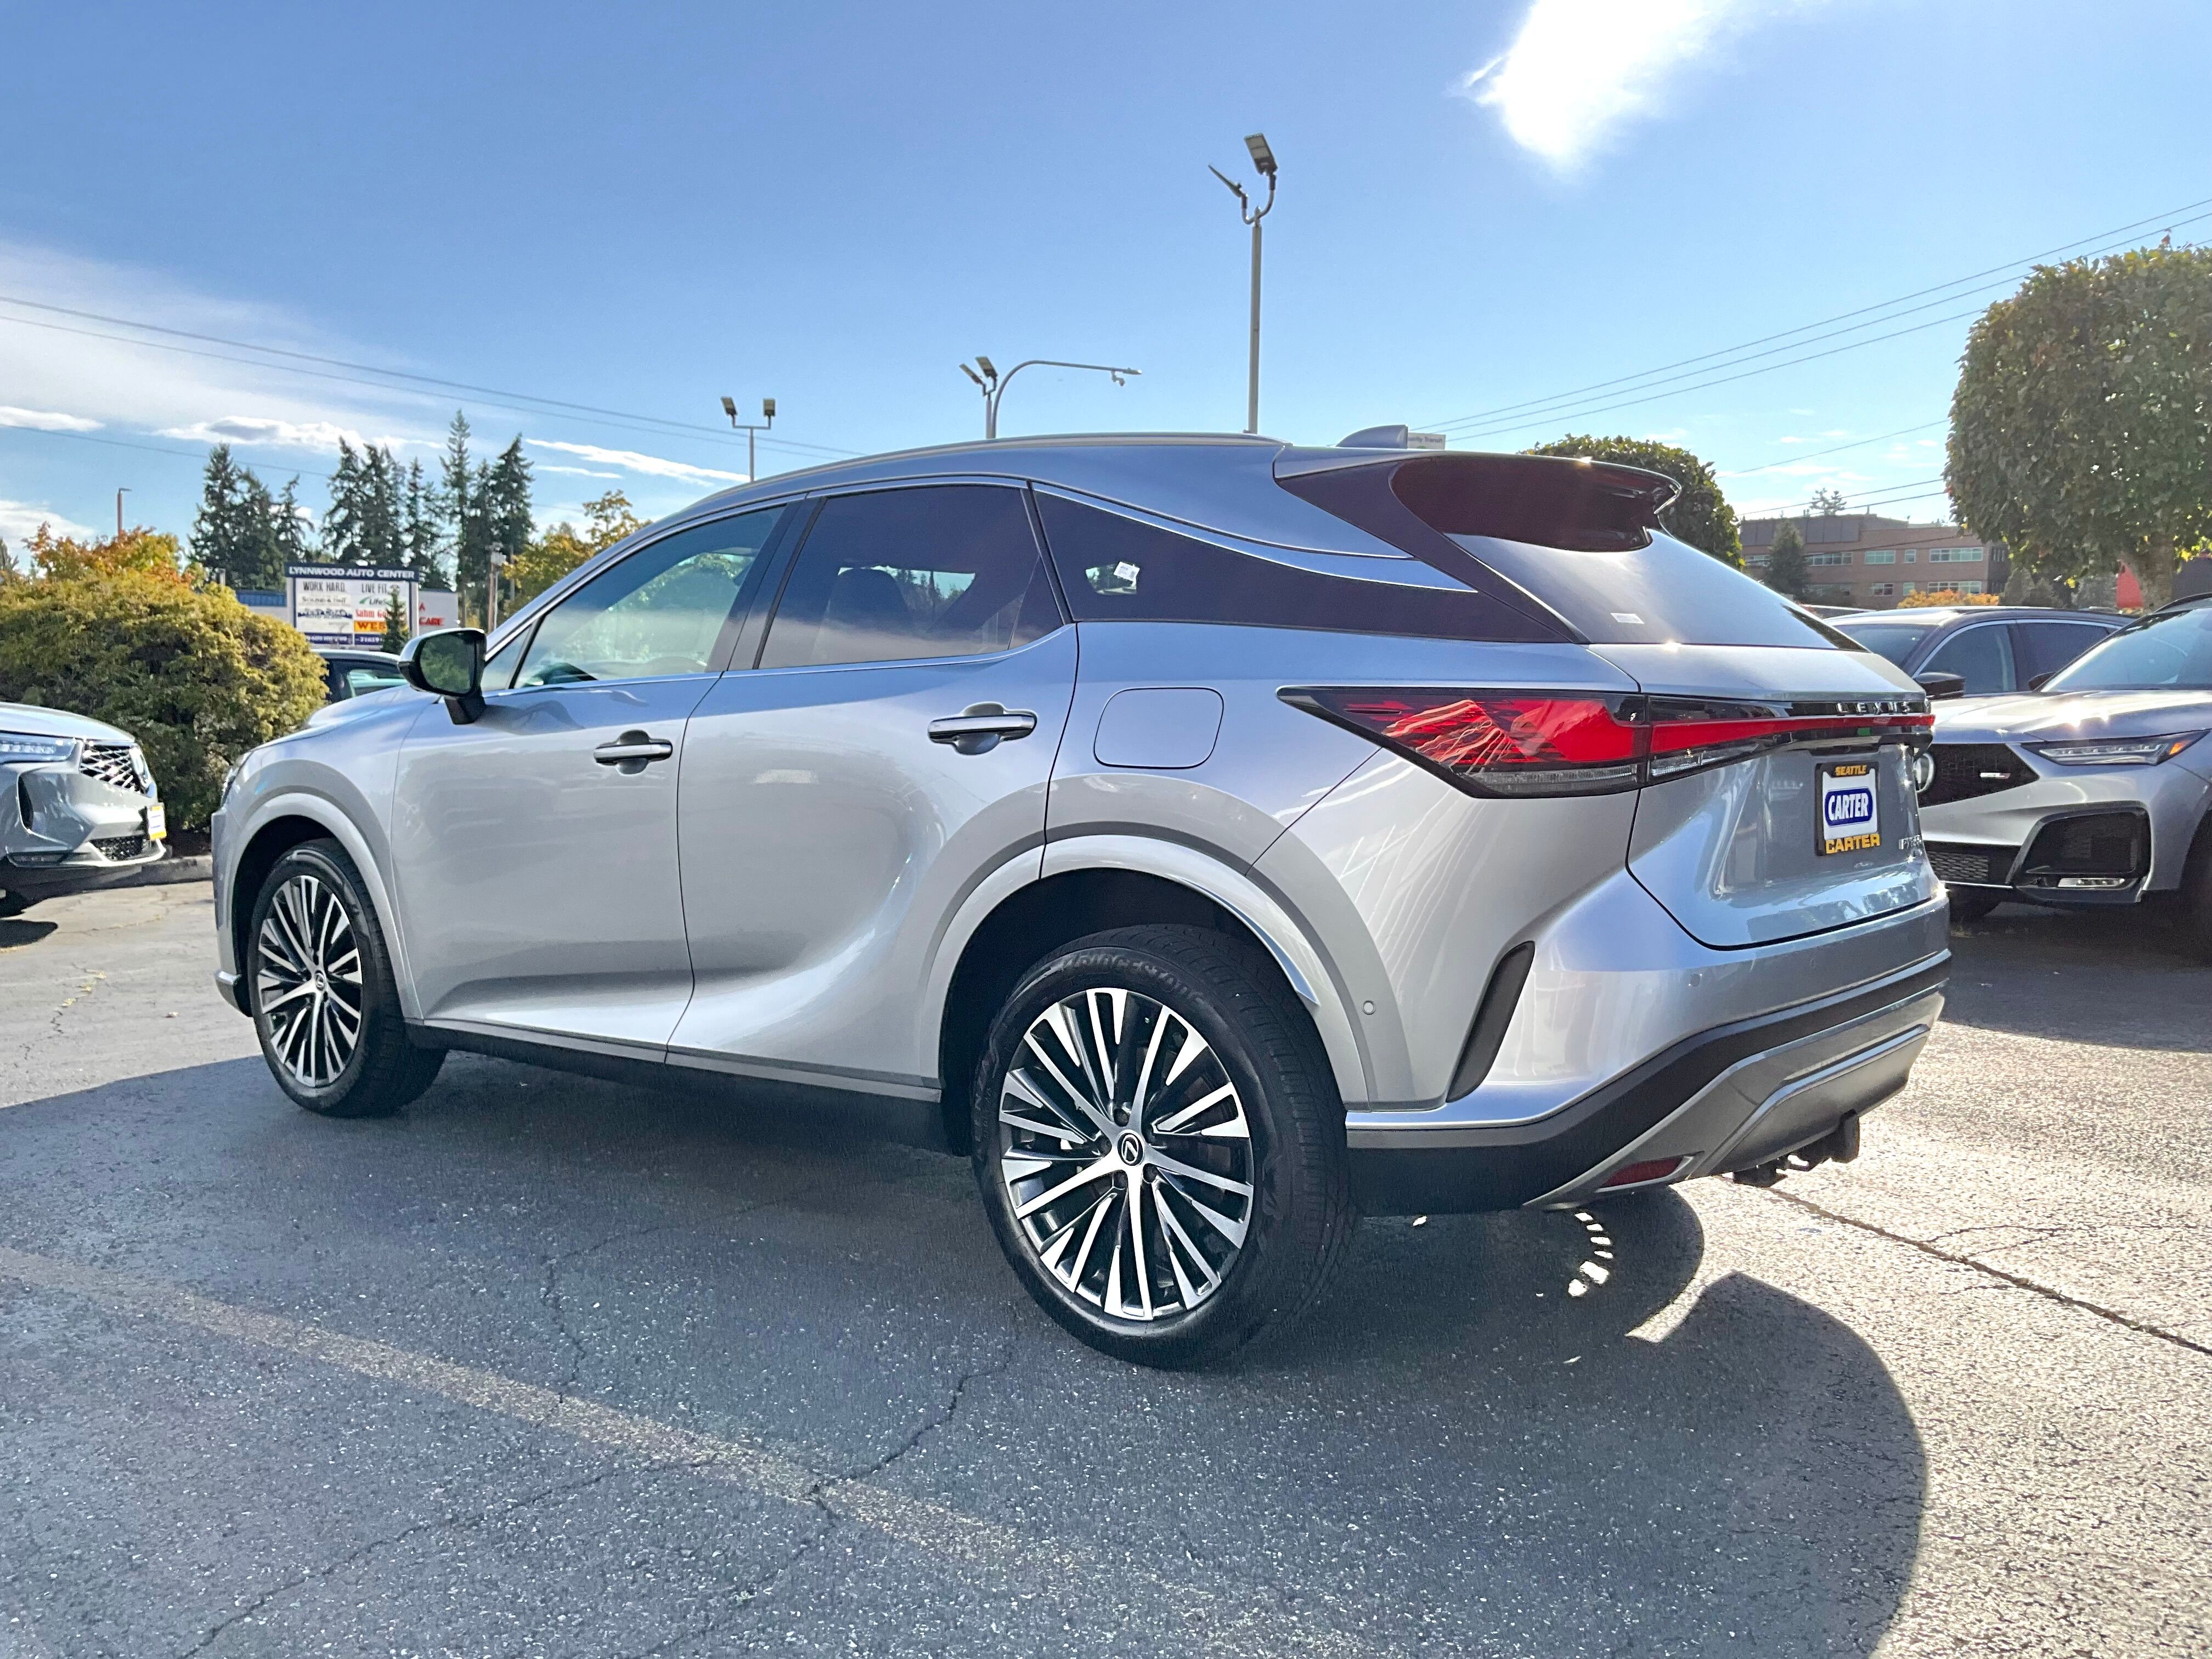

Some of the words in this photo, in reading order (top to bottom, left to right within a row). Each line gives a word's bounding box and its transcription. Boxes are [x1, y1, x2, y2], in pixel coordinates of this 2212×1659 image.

[289, 566, 345, 576] LYNNWOOD
[346, 568, 374, 578] AUTO
[377, 569, 415, 579] CENTER
[303, 581, 323, 591] WORK
[362, 583, 374, 593] LIVE
[419, 617, 444, 626] CARE
[1836, 701, 1911, 714] LEXUS
[1835, 765, 1866, 776] SEATTLE
[1828, 792, 1869, 821] CARTER
[1825, 833, 1880, 854] CARTER
